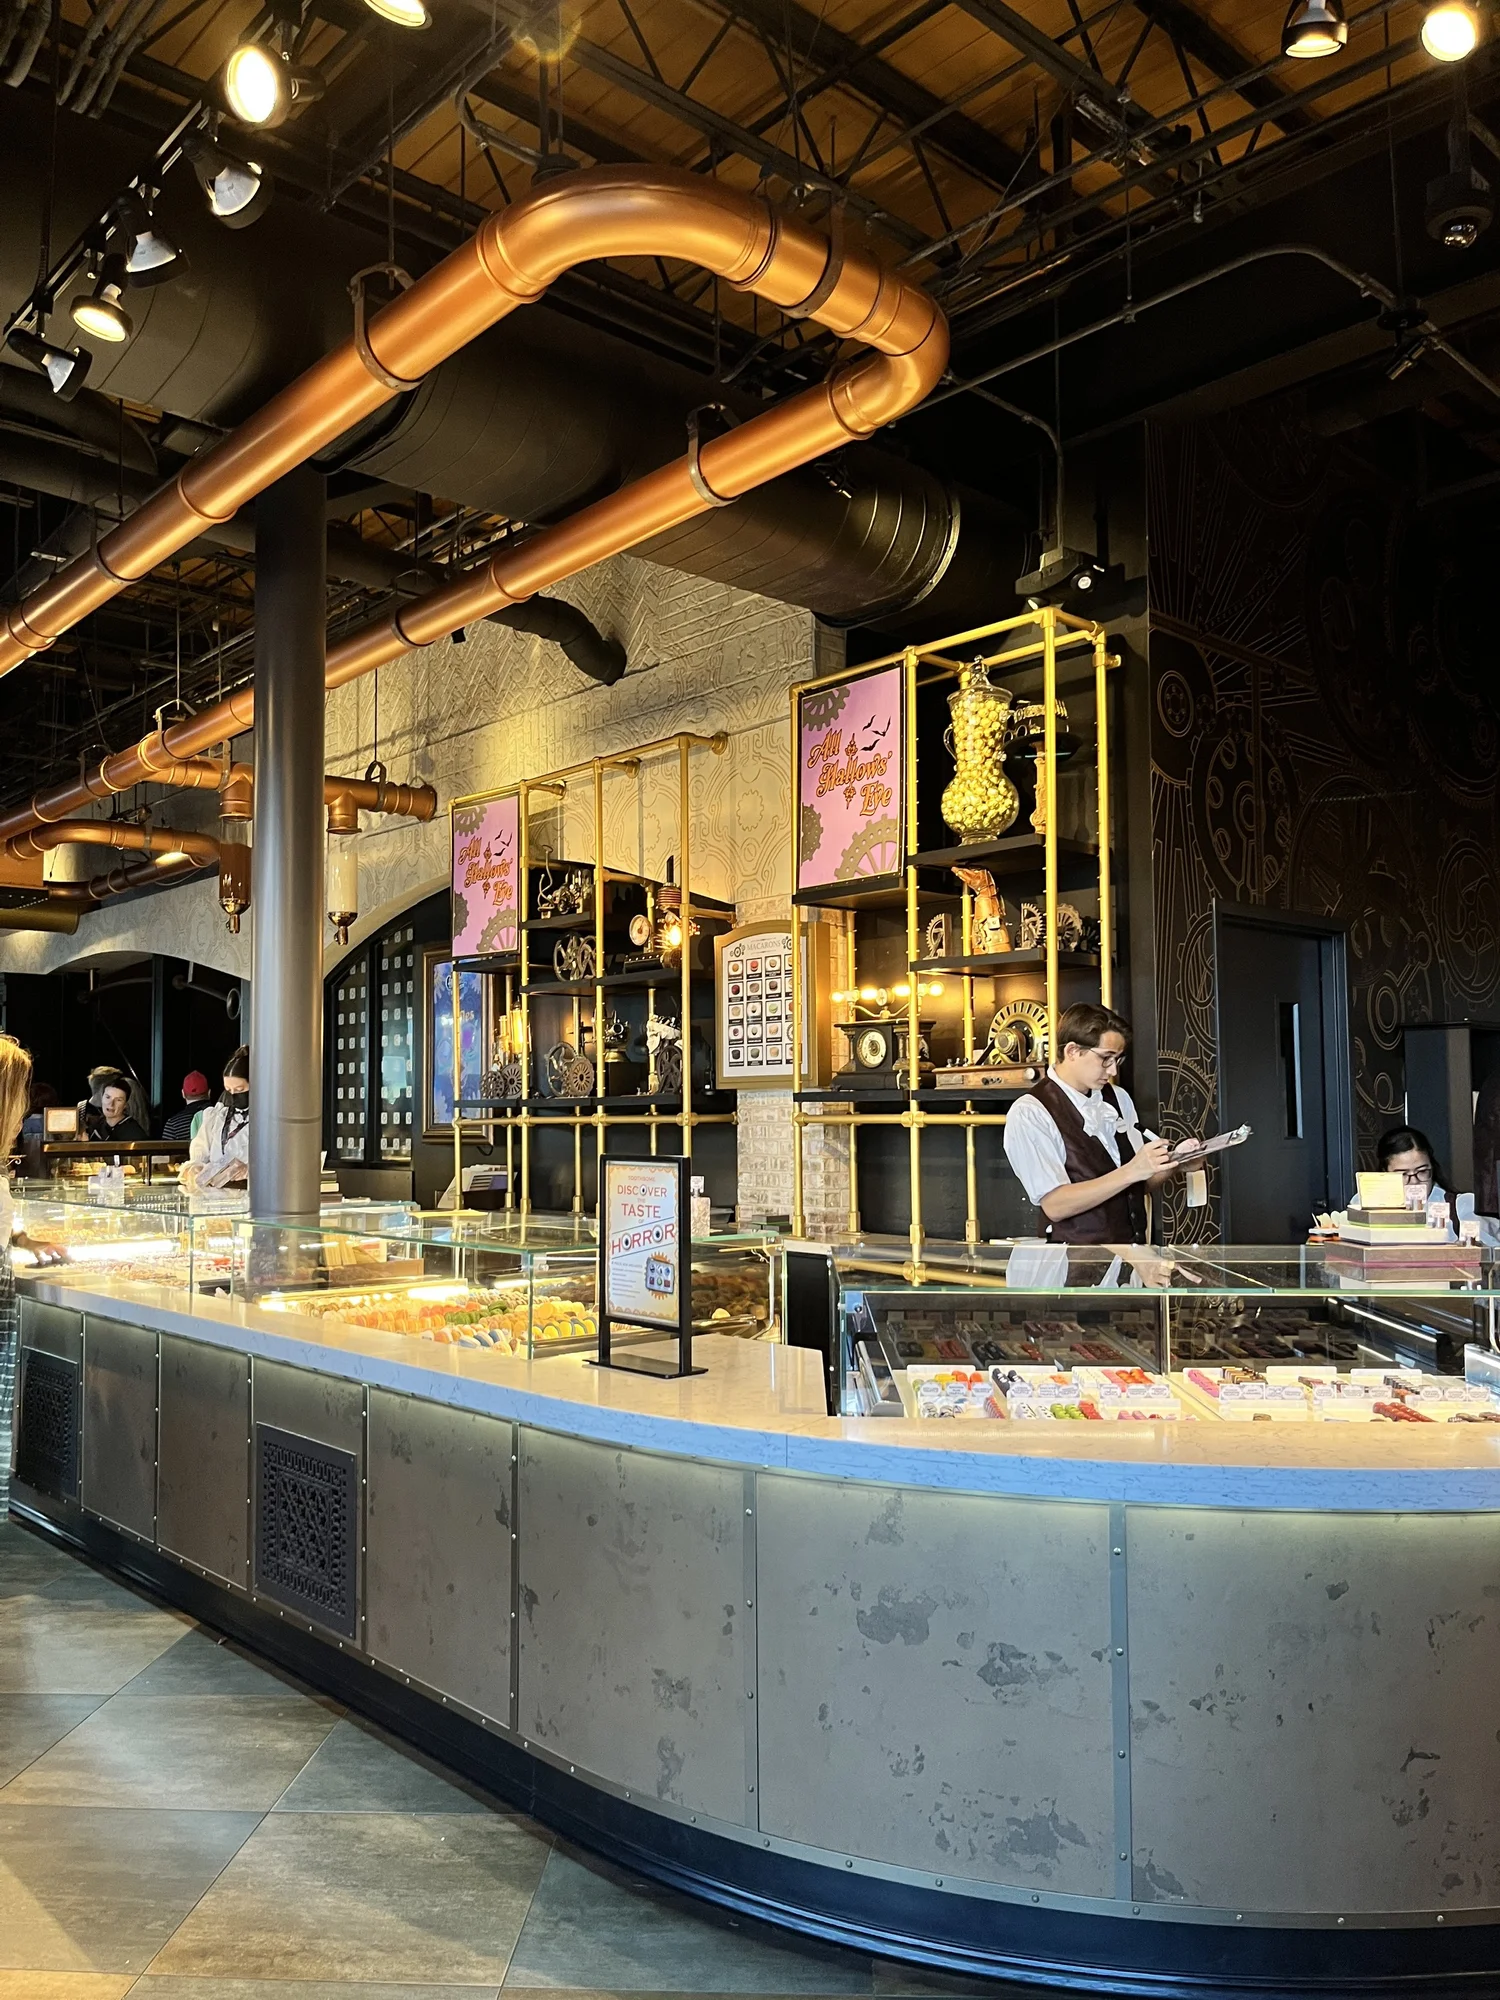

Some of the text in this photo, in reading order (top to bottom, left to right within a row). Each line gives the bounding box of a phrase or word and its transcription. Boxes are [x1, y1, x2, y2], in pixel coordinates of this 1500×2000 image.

[807, 728, 842, 769] All
[860, 780, 893, 816] Eve
[458, 835, 482, 865] All
[746, 940, 781, 950] MACARONS
[617, 1184, 668, 1197] DISCOVER
[621, 1203, 661, 1219] TASTE
[611, 1223, 675, 1255] HORROR
